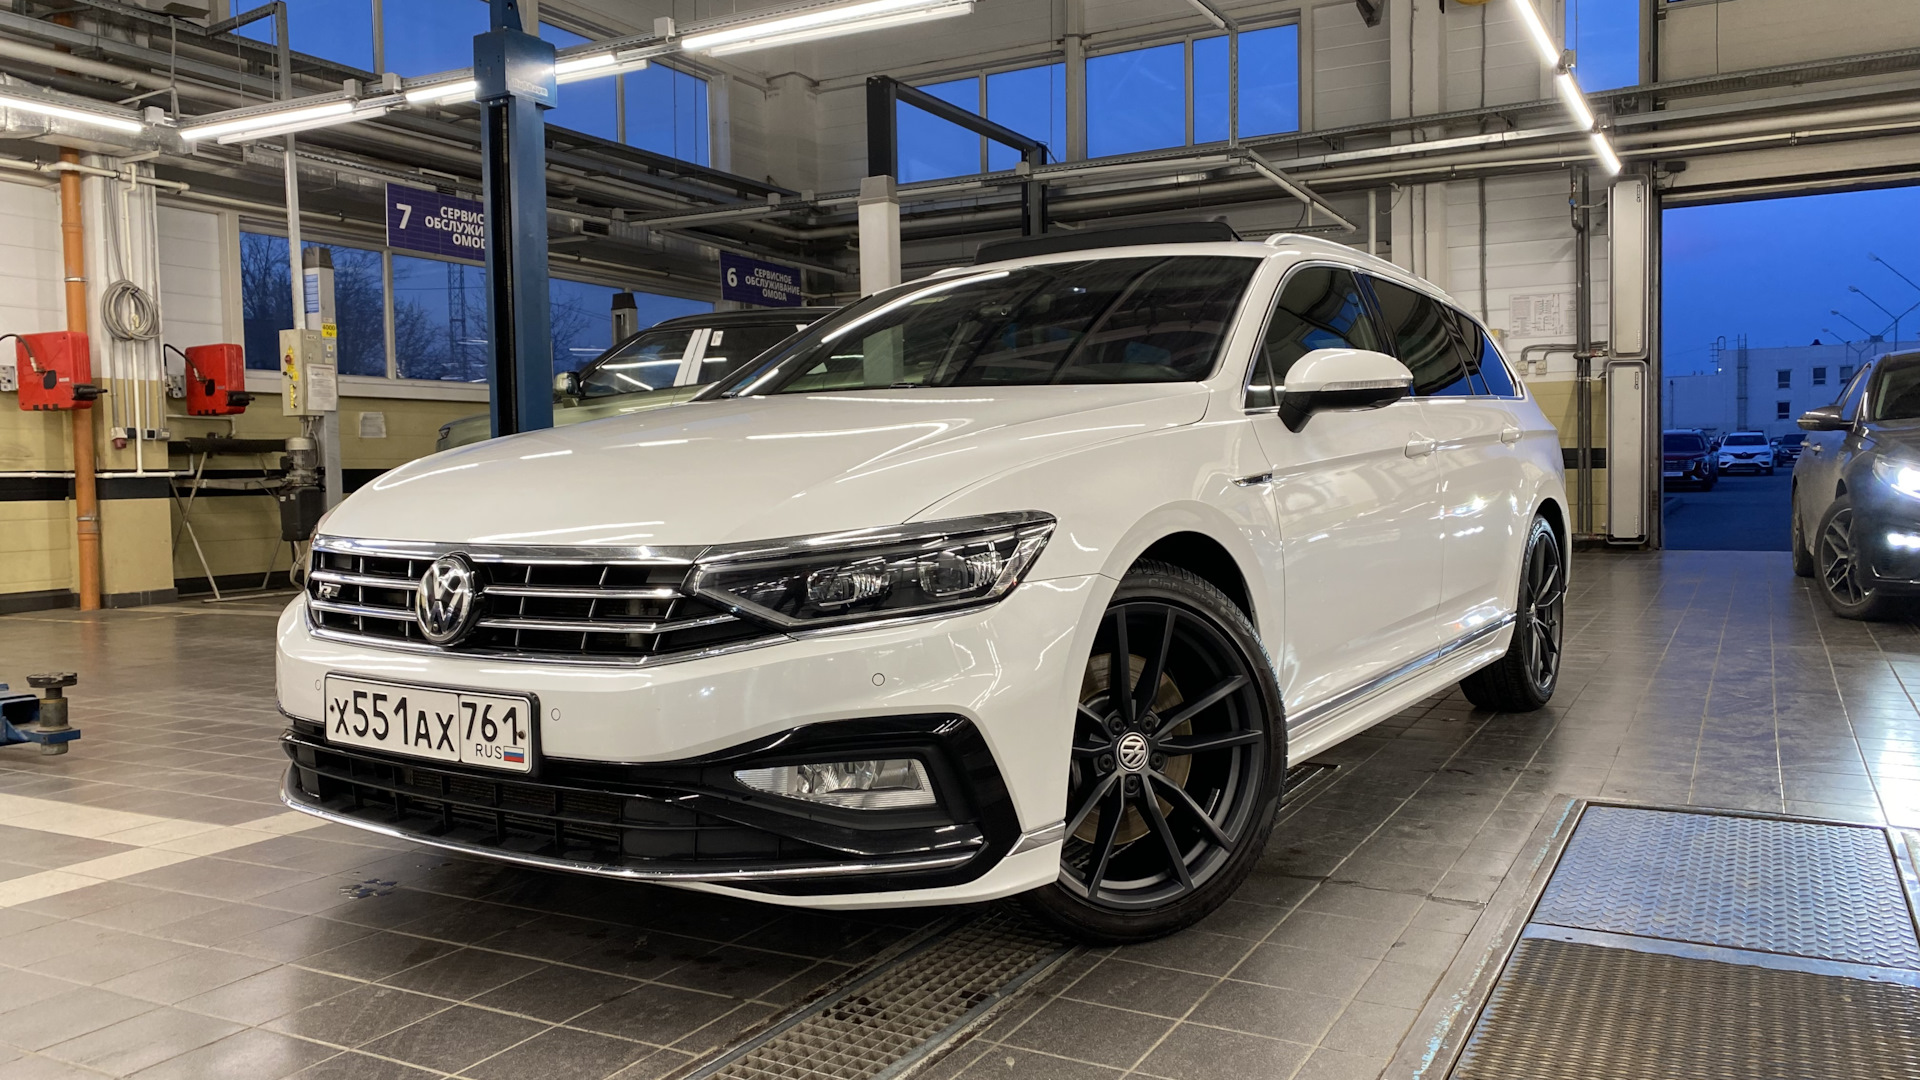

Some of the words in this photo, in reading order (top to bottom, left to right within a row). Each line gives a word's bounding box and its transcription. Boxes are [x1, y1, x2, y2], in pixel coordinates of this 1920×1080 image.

[396, 203, 412, 230] 7
[726, 267, 738, 288] 6
[744, 275, 800, 296] ОБСЛУЖИВАНИЕ
[754, 267, 792, 285] СЕРВИСНОЕ
[461, 701, 518, 746] 761
[475, 743, 502, 760] RUS
